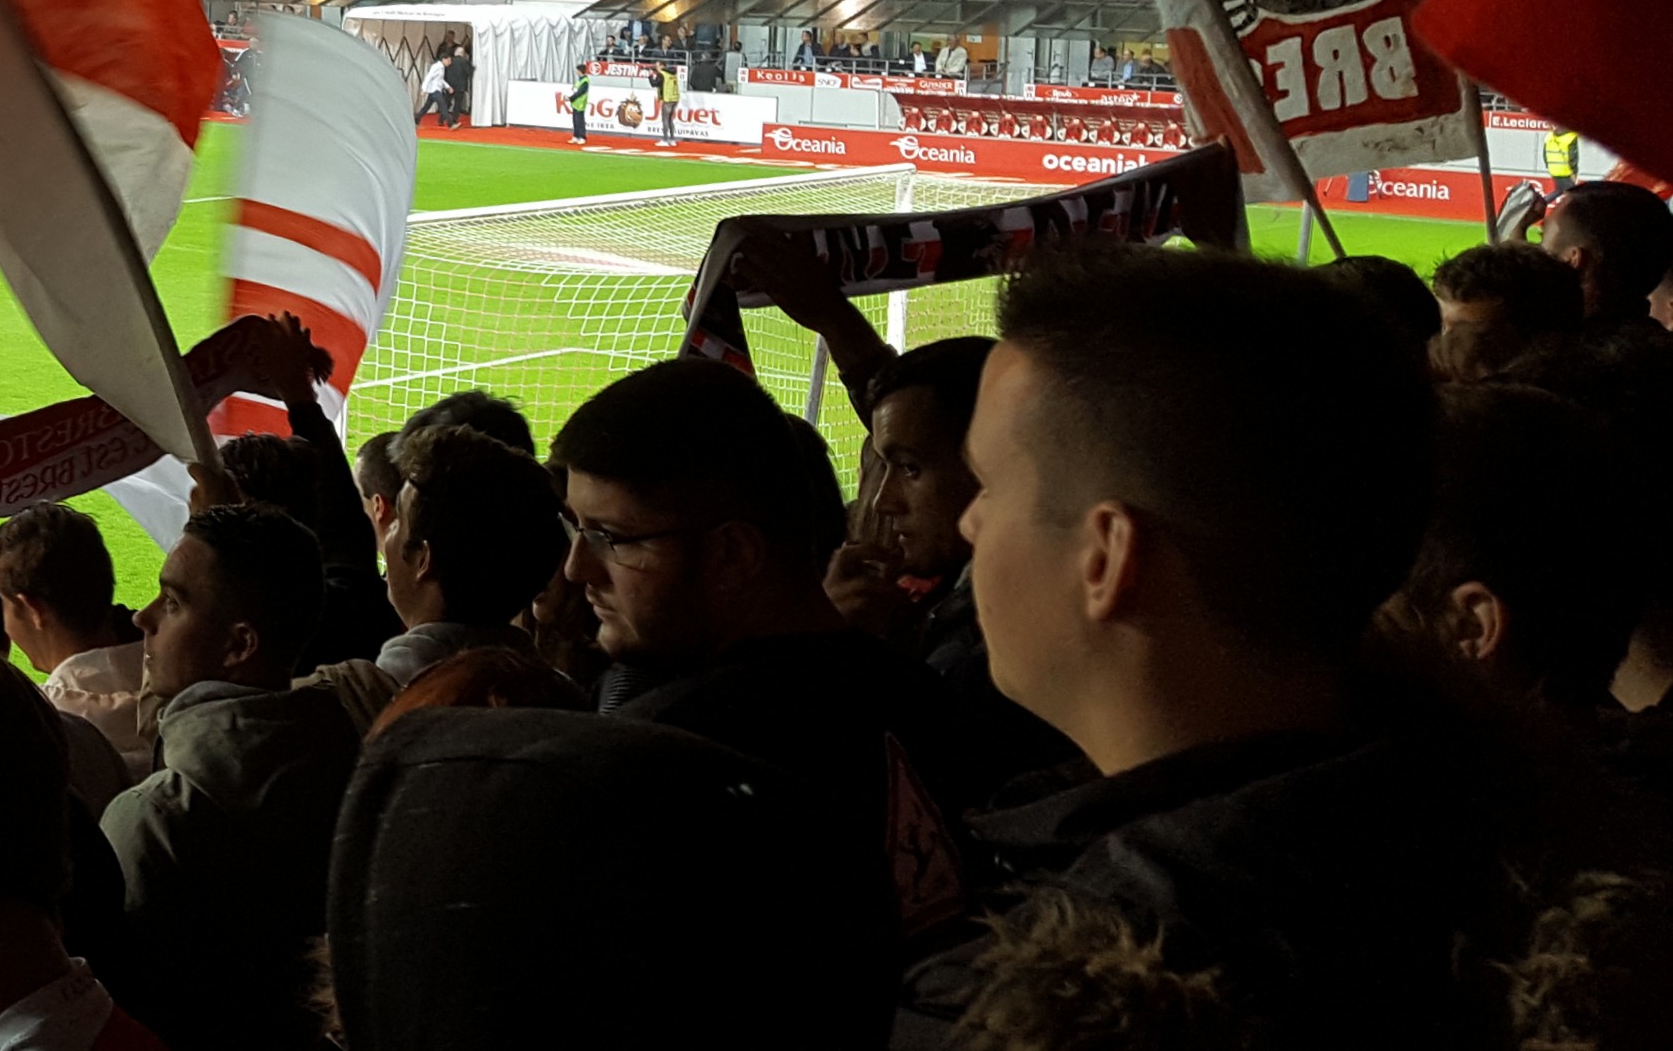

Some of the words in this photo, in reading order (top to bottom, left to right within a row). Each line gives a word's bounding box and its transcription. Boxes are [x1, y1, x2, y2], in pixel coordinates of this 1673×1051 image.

[605, 63, 639, 77] JESTIN
[645, 97, 721, 126] Juet
[675, 128, 709, 138] UIPAVAS
[773, 127, 847, 155] Oceania
[898, 135, 975, 164] Oceania
